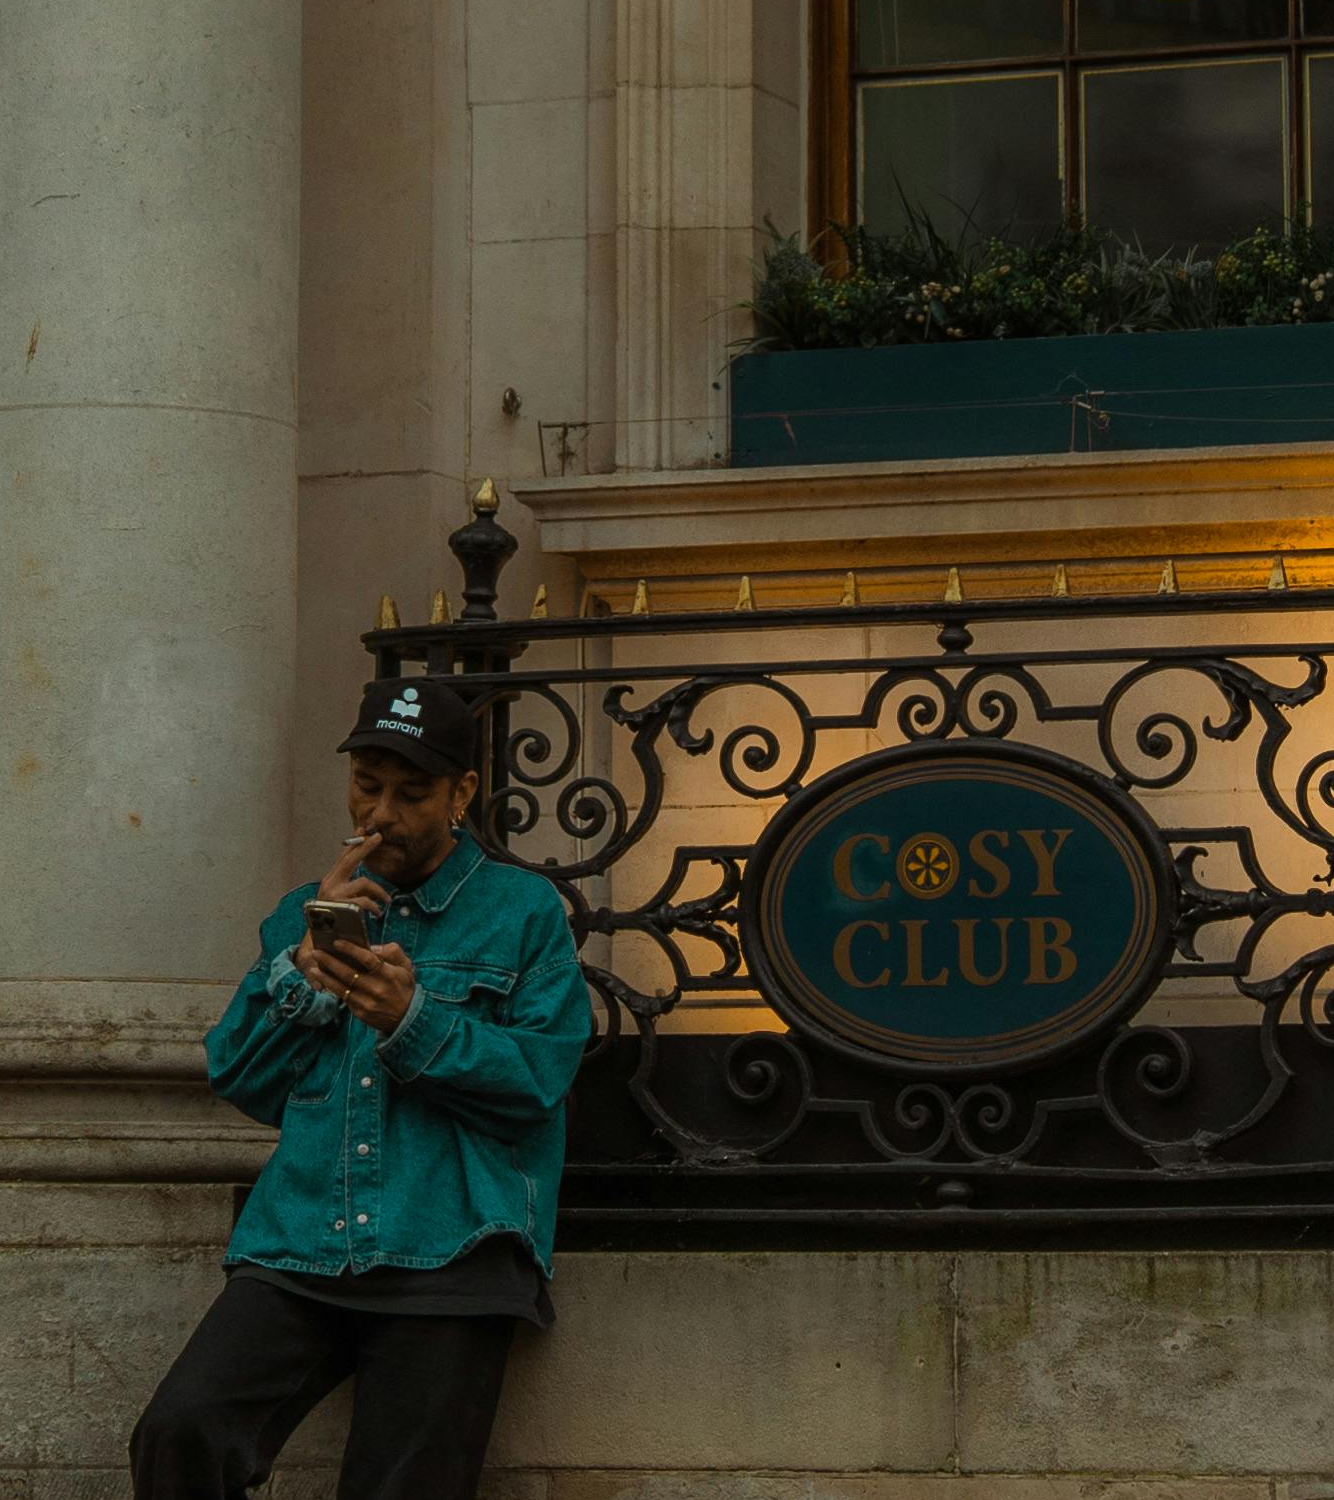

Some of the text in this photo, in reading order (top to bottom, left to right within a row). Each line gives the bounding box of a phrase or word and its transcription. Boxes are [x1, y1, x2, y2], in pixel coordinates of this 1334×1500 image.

[376, 719, 424, 738] marant
[832, 828, 1075, 901] COSY
[832, 916, 1078, 989] CLUB
